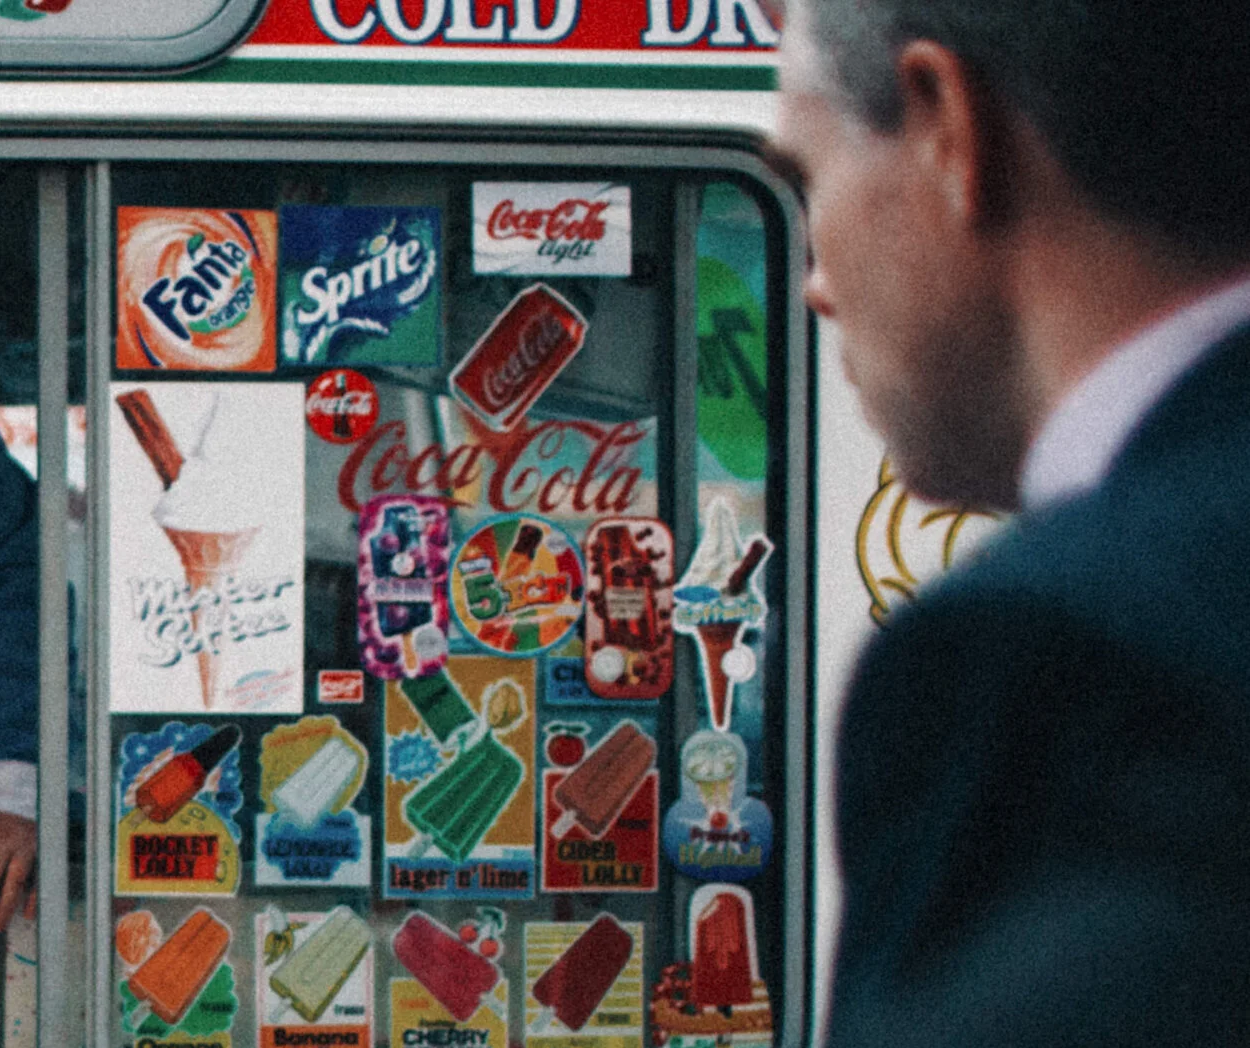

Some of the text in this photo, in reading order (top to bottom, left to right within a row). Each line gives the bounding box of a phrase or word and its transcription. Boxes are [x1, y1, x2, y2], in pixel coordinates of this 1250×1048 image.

[537, 241, 595, 263] light
[143, 240, 246, 341] Fanta
[297, 236, 422, 325] Sprite
[209, 279, 256, 328] orange
[133, 856, 196, 879] LOLLY
[390, 864, 448, 891] lager
[582, 863, 643, 886] LOLLY
[273, 1028, 359, 1047] Banana
[403, 1028, 490, 1046] CHERRY
